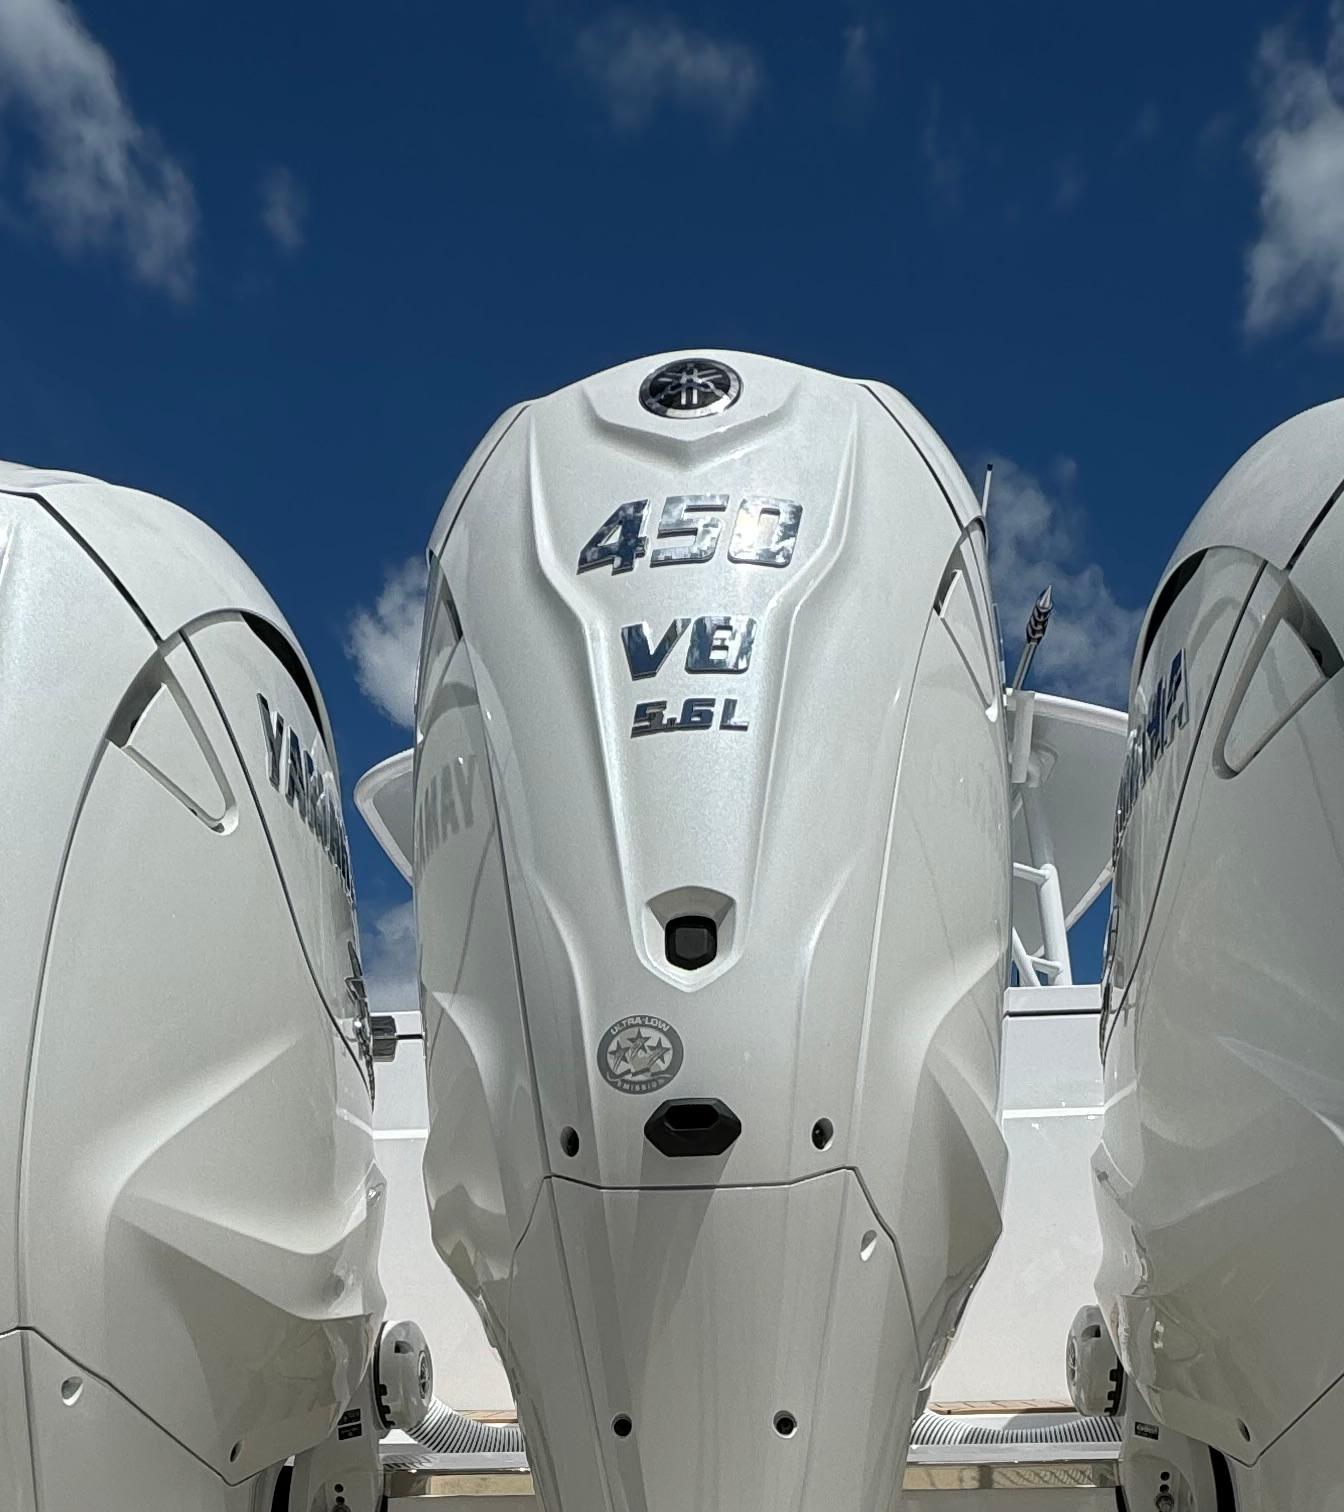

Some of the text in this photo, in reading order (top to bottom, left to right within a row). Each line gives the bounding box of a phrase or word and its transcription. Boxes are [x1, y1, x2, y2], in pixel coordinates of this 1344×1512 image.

[577, 494, 804, 576] 450
[621, 616, 756, 681] V8
[630, 697, 750, 739] 5.6L
[610, 1016, 670, 1035] ULTRA LOW
